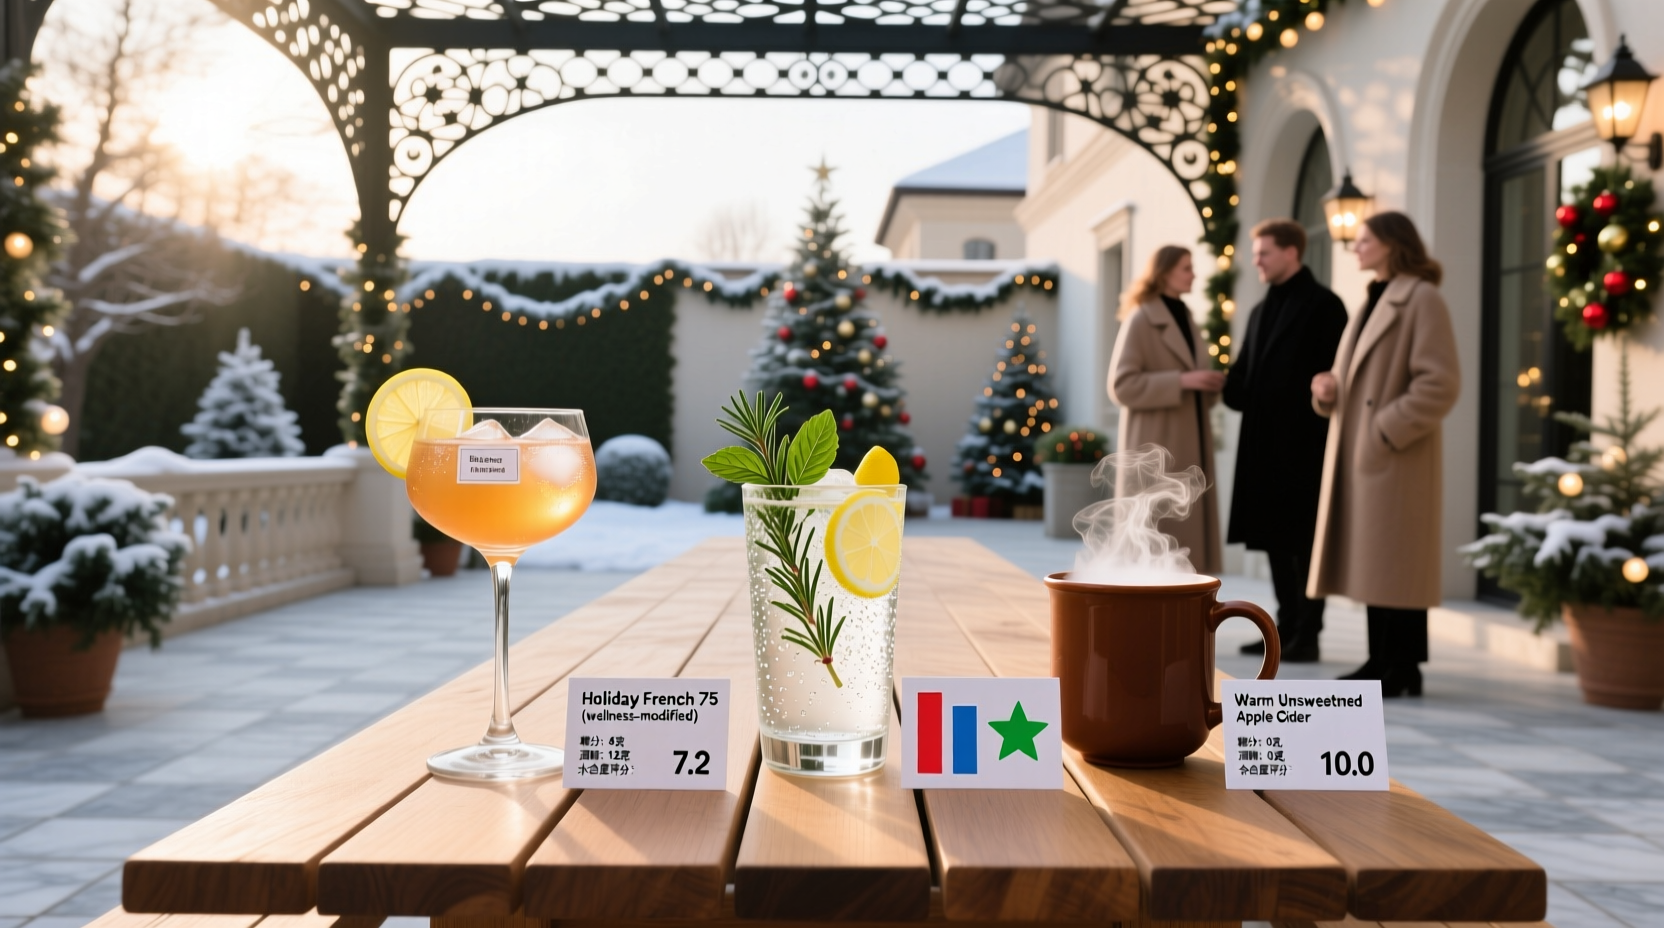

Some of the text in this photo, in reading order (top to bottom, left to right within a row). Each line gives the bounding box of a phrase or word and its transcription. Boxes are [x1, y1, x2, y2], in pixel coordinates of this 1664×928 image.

[582, 691, 718, 709] Holiday French 75
[1234, 693, 1274, 707] Warm
[1237, 710, 1311, 726] Apple Cider
[673, 750, 710, 775] 7.2
[1320, 751, 1374, 776] 10.0
